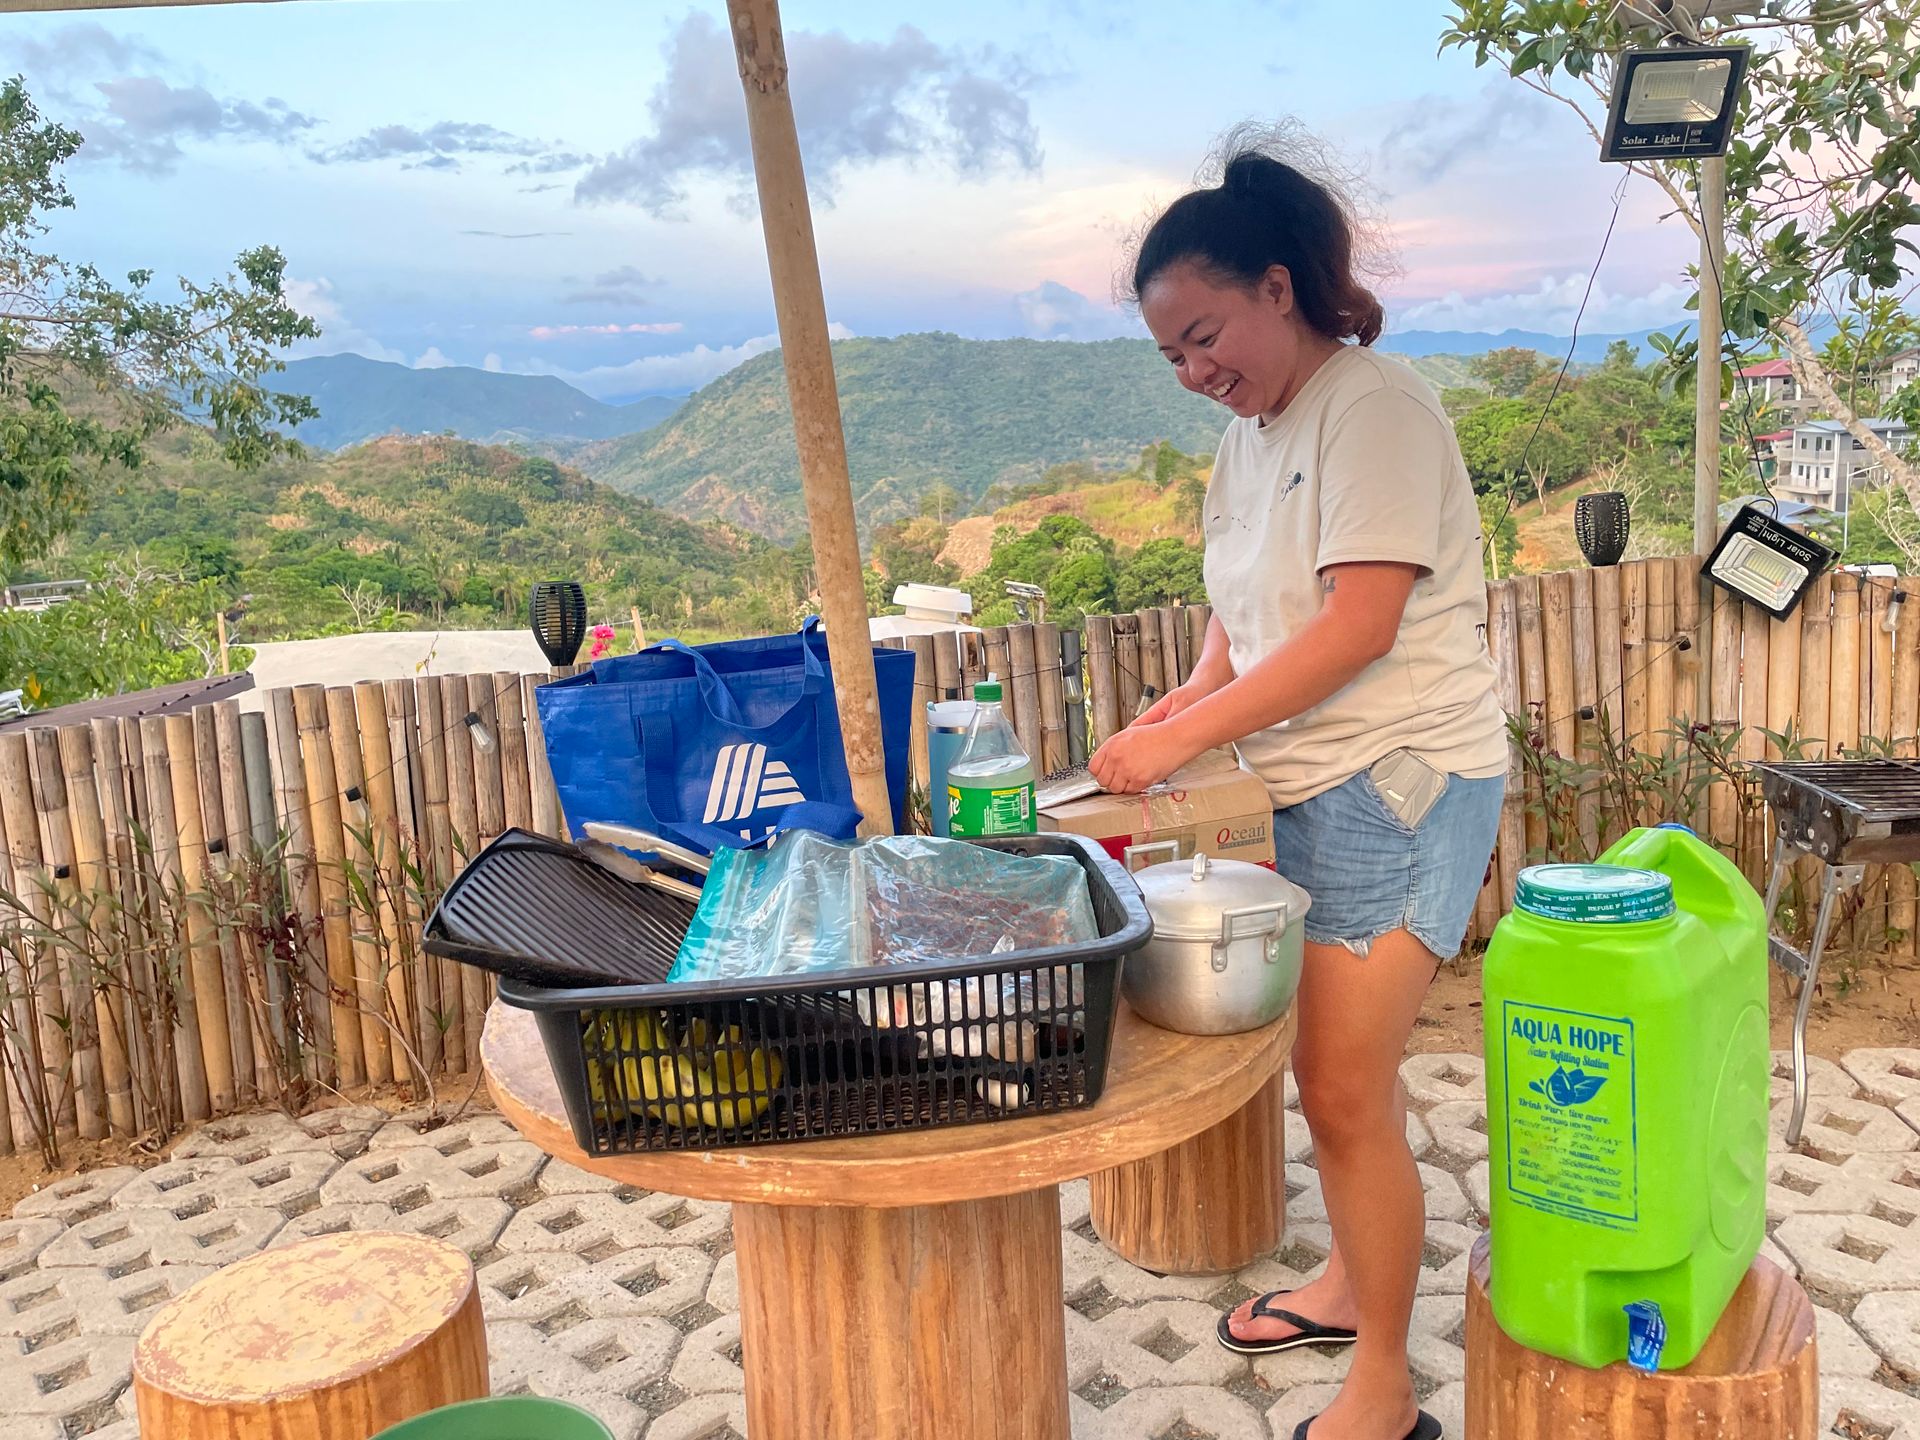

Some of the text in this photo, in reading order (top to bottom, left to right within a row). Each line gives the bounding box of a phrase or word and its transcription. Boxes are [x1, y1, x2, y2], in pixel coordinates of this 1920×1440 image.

[1622, 136, 1647, 145] Solar
[1654, 134, 1681, 146] Light
[1762, 530, 1812, 562] Solar Light
[1216, 825, 1265, 845] Ocean
[1558, 894, 1583, 902] REFUSE
[1592, 892, 1609, 900] SEAL
[1550, 905, 1577, 913] BROKEN
[1587, 903, 1614, 912] REFUSE
[1624, 908, 1648, 917] REFUSE
[1511, 1016, 1626, 1057] AQUA HOPE
[1550, 1049, 1581, 1067] Refilling
[1582, 1055, 1609, 1070] Station
[1518, 1097, 1541, 1110] Drink
[1568, 1150, 1601, 1162] NUMBER
